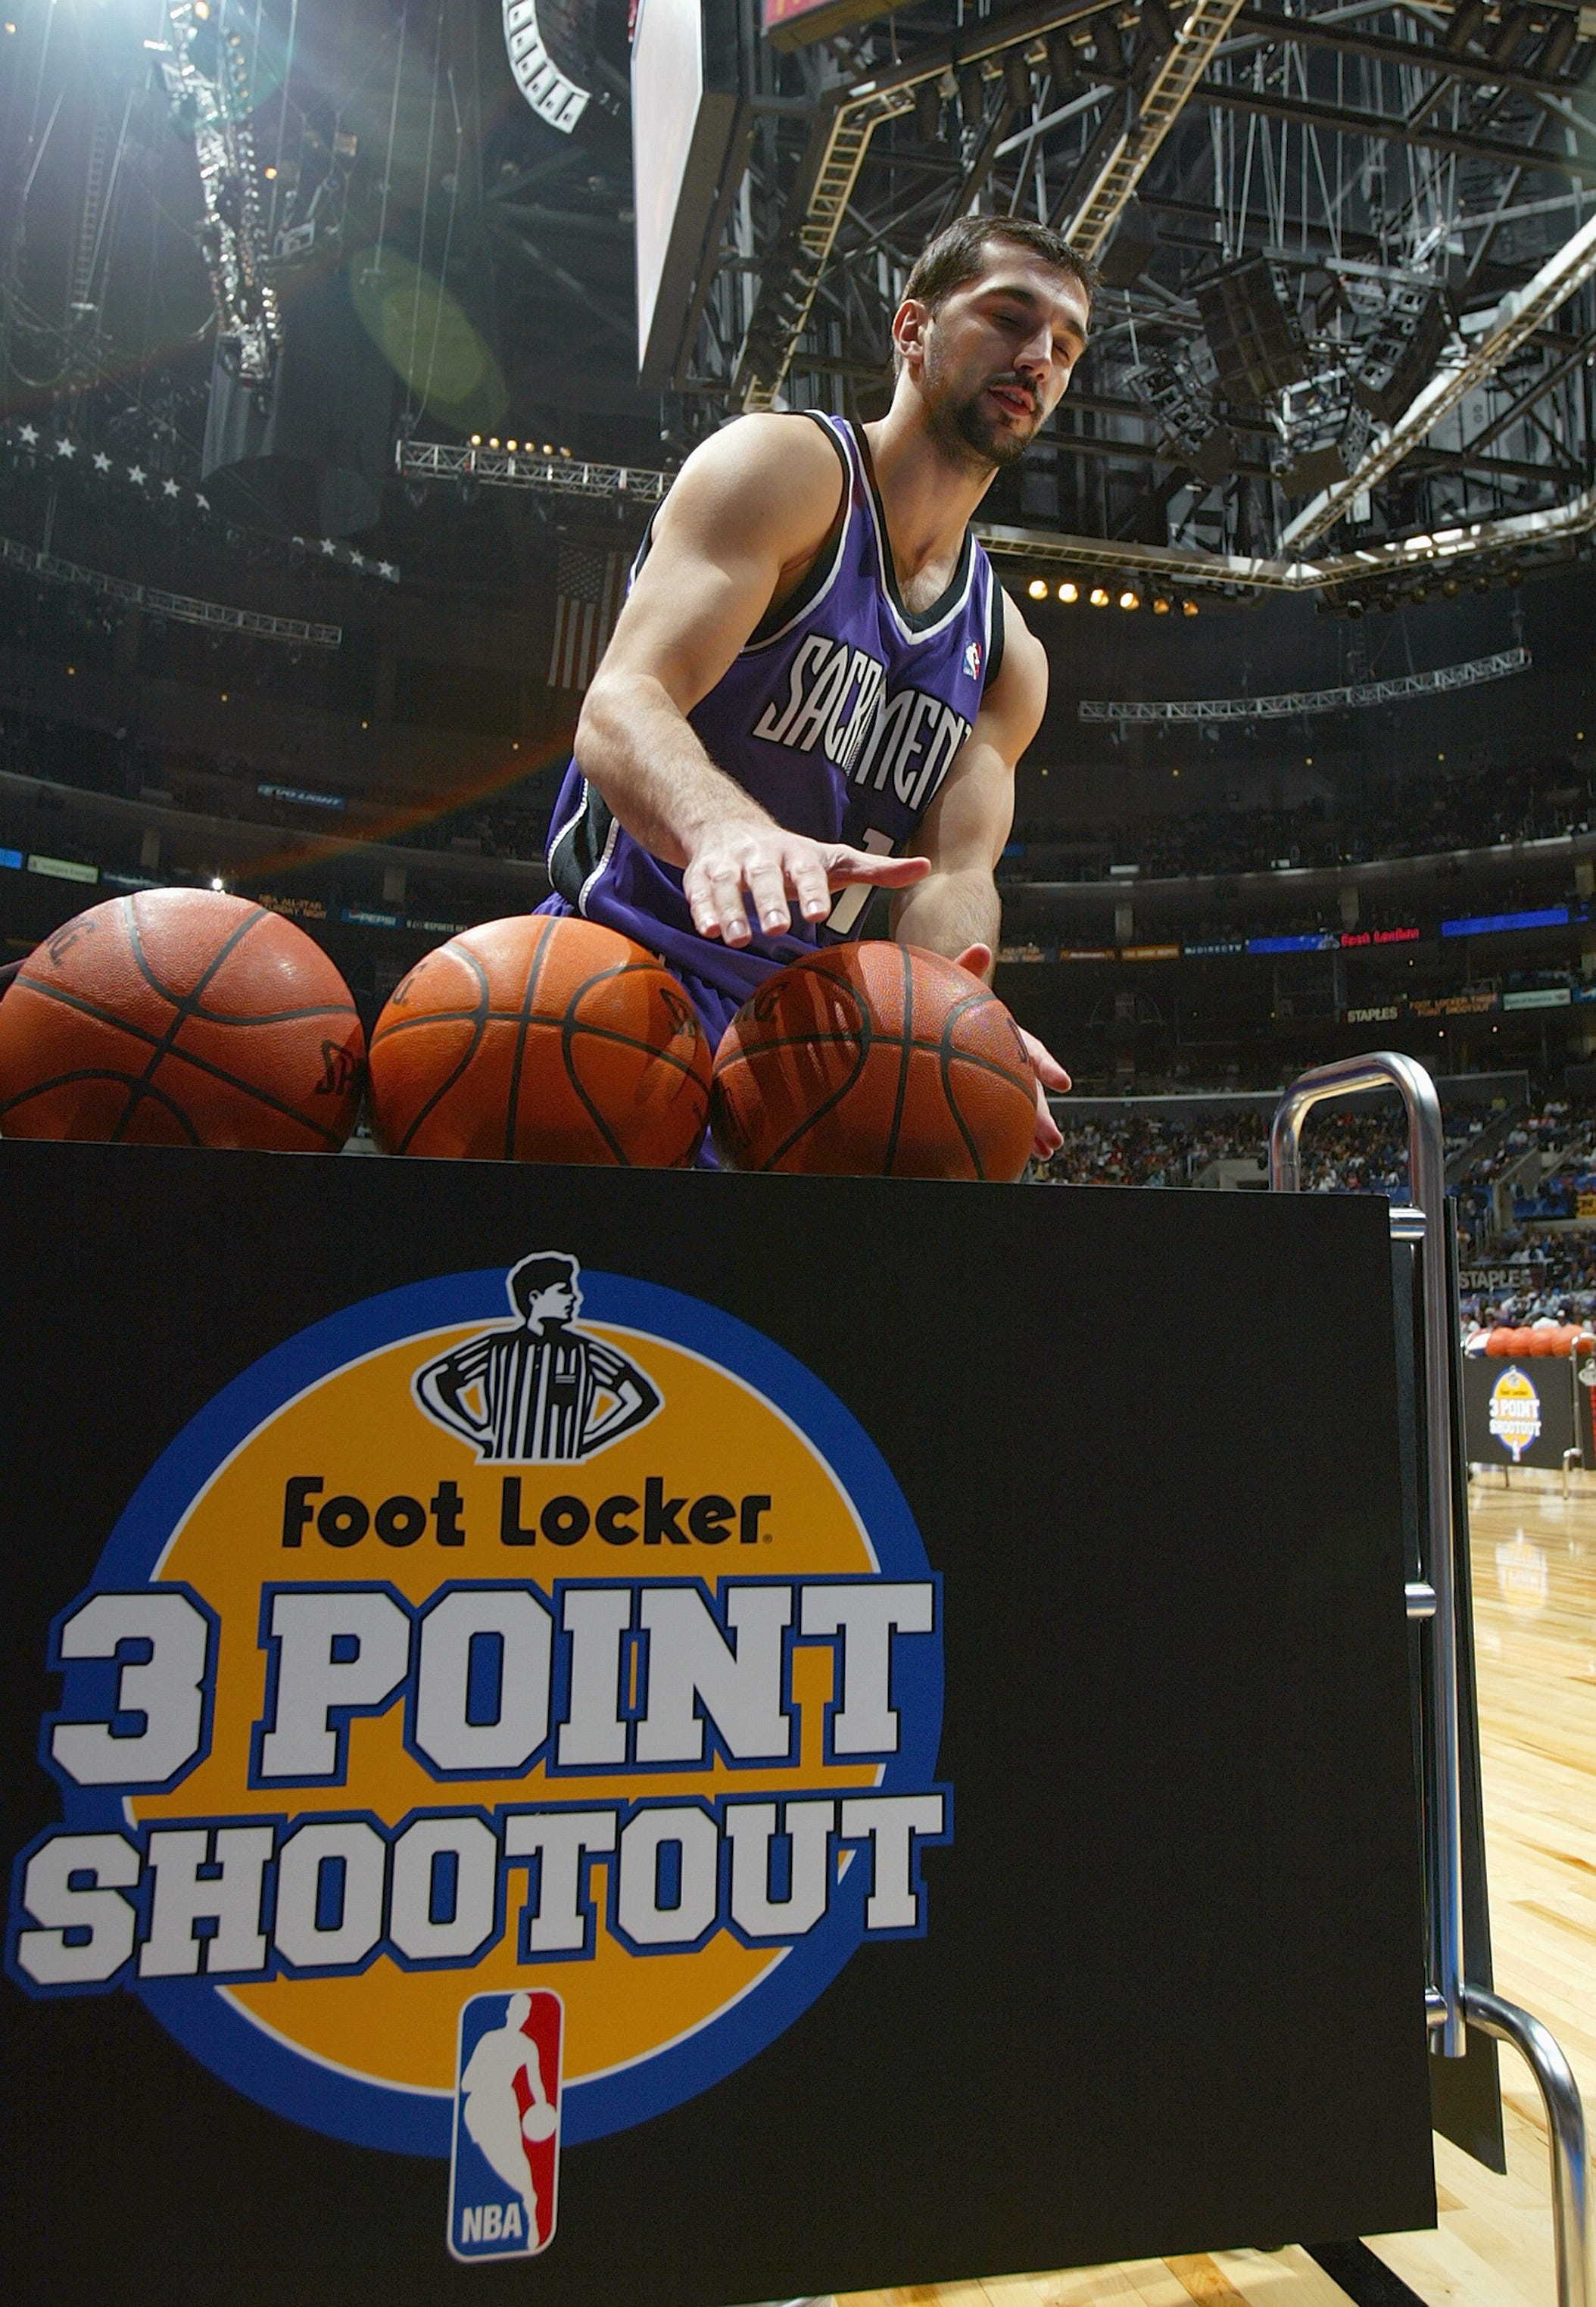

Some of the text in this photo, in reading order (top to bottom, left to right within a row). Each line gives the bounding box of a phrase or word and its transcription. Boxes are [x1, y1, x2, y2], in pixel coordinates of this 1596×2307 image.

[1347, 1005, 1398, 1024] STAPLES
[1458, 1268, 1533, 1290] STAPLES
[1488, 1398, 1540, 1418] 3 POINT
[282, 1476, 772, 1548] Foot Locker
[50, 1582, 934, 1786] 3 POINT
[17, 1794, 944, 1986] SHOOTOUT
[461, 2201, 523, 2244] NBA
